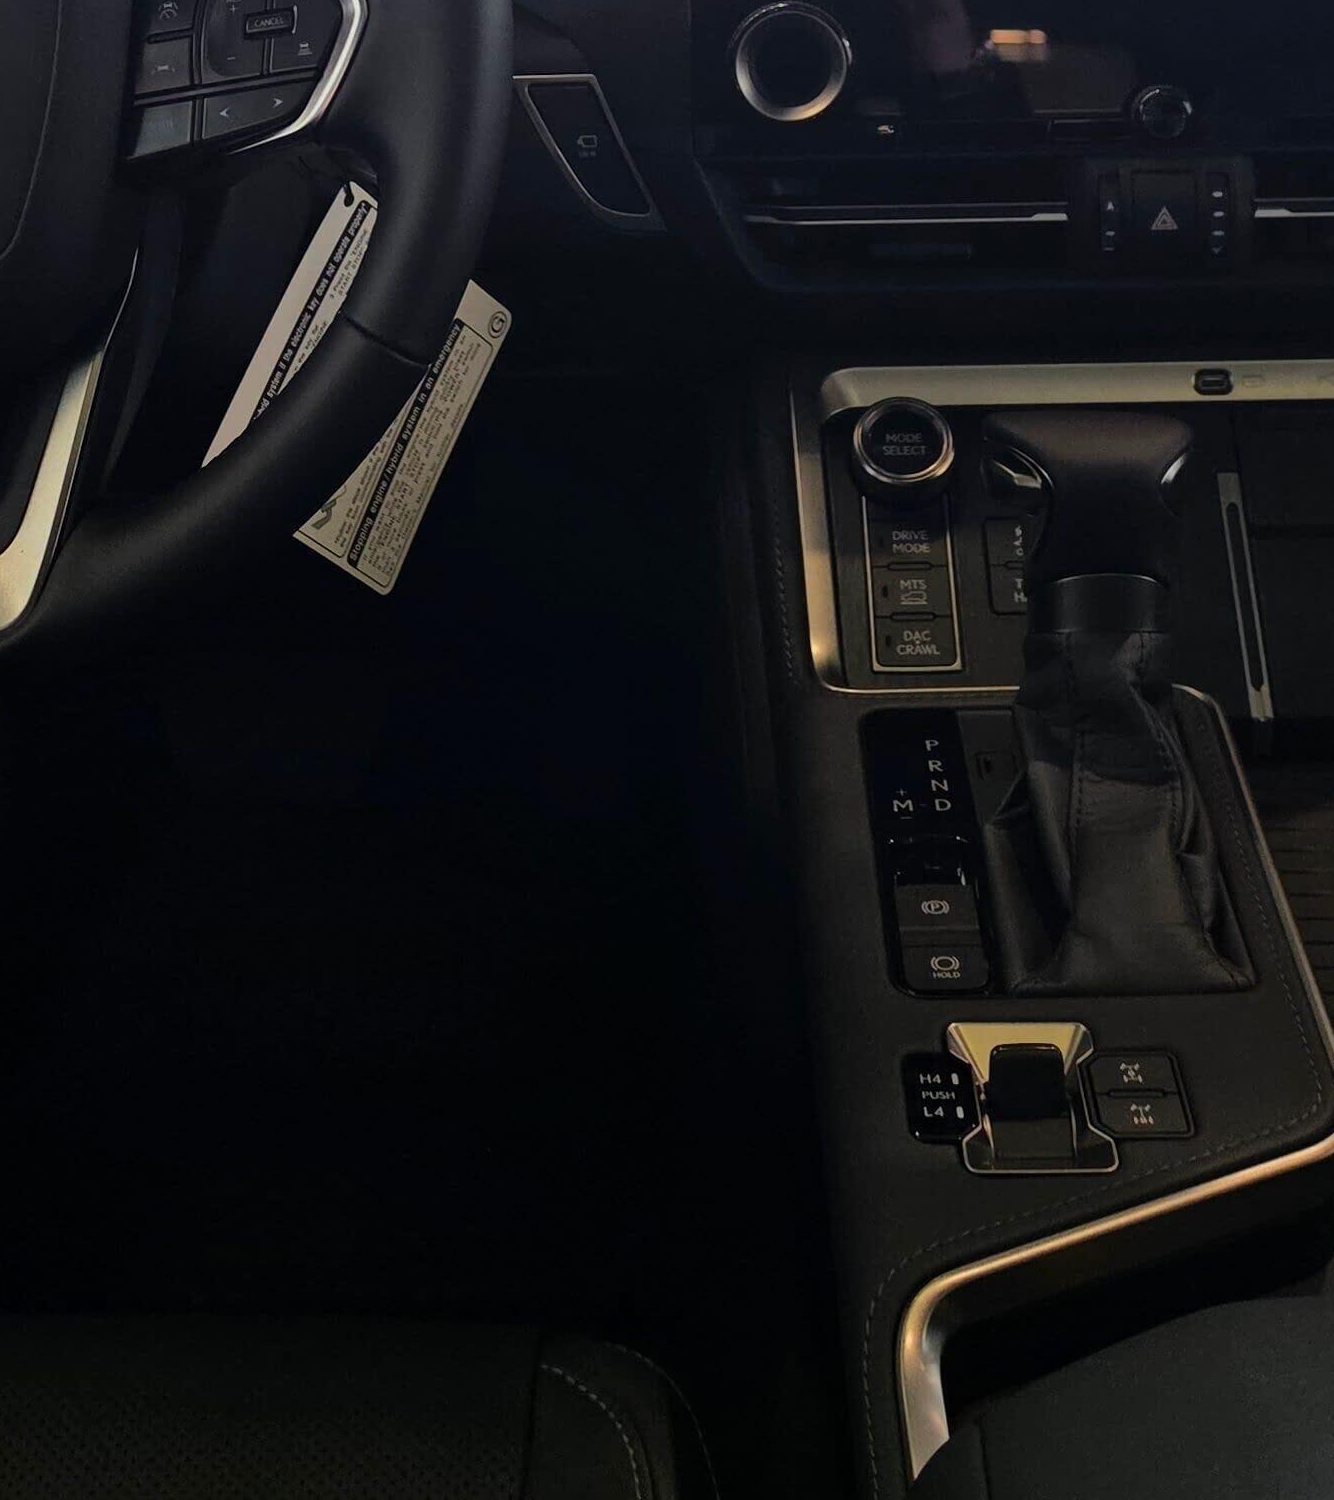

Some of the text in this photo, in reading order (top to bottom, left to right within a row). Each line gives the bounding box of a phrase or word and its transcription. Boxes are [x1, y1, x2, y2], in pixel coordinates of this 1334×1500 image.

[253, 16, 285, 28] CANCEL
[349, 516, 373, 560] Stopping
[401, 405, 420, 440] system
[417, 392, 427, 403] in
[424, 376, 434, 390] an
[432, 323, 460, 374] emergency
[885, 432, 923, 443] MODE
[883, 445, 927, 456] SELECT
[892, 530, 929, 541] DRIVE
[892, 543, 930, 553] MODE
[900, 579, 927, 590] MTS
[903, 630, 931, 642] DAC
[896, 644, 940, 655] CRAWL
[925, 739, 940, 752] P
[928, 759, 944, 773] R
[931, 779, 949, 792] N
[892, 799, 914, 813] M
[934, 798, 952, 812] D
[932, 971, 961, 979] HOLD
[919, 1073, 941, 1085] H4
[921, 1091, 956, 1100] PUSH
[923, 1105, 944, 1117] L4
